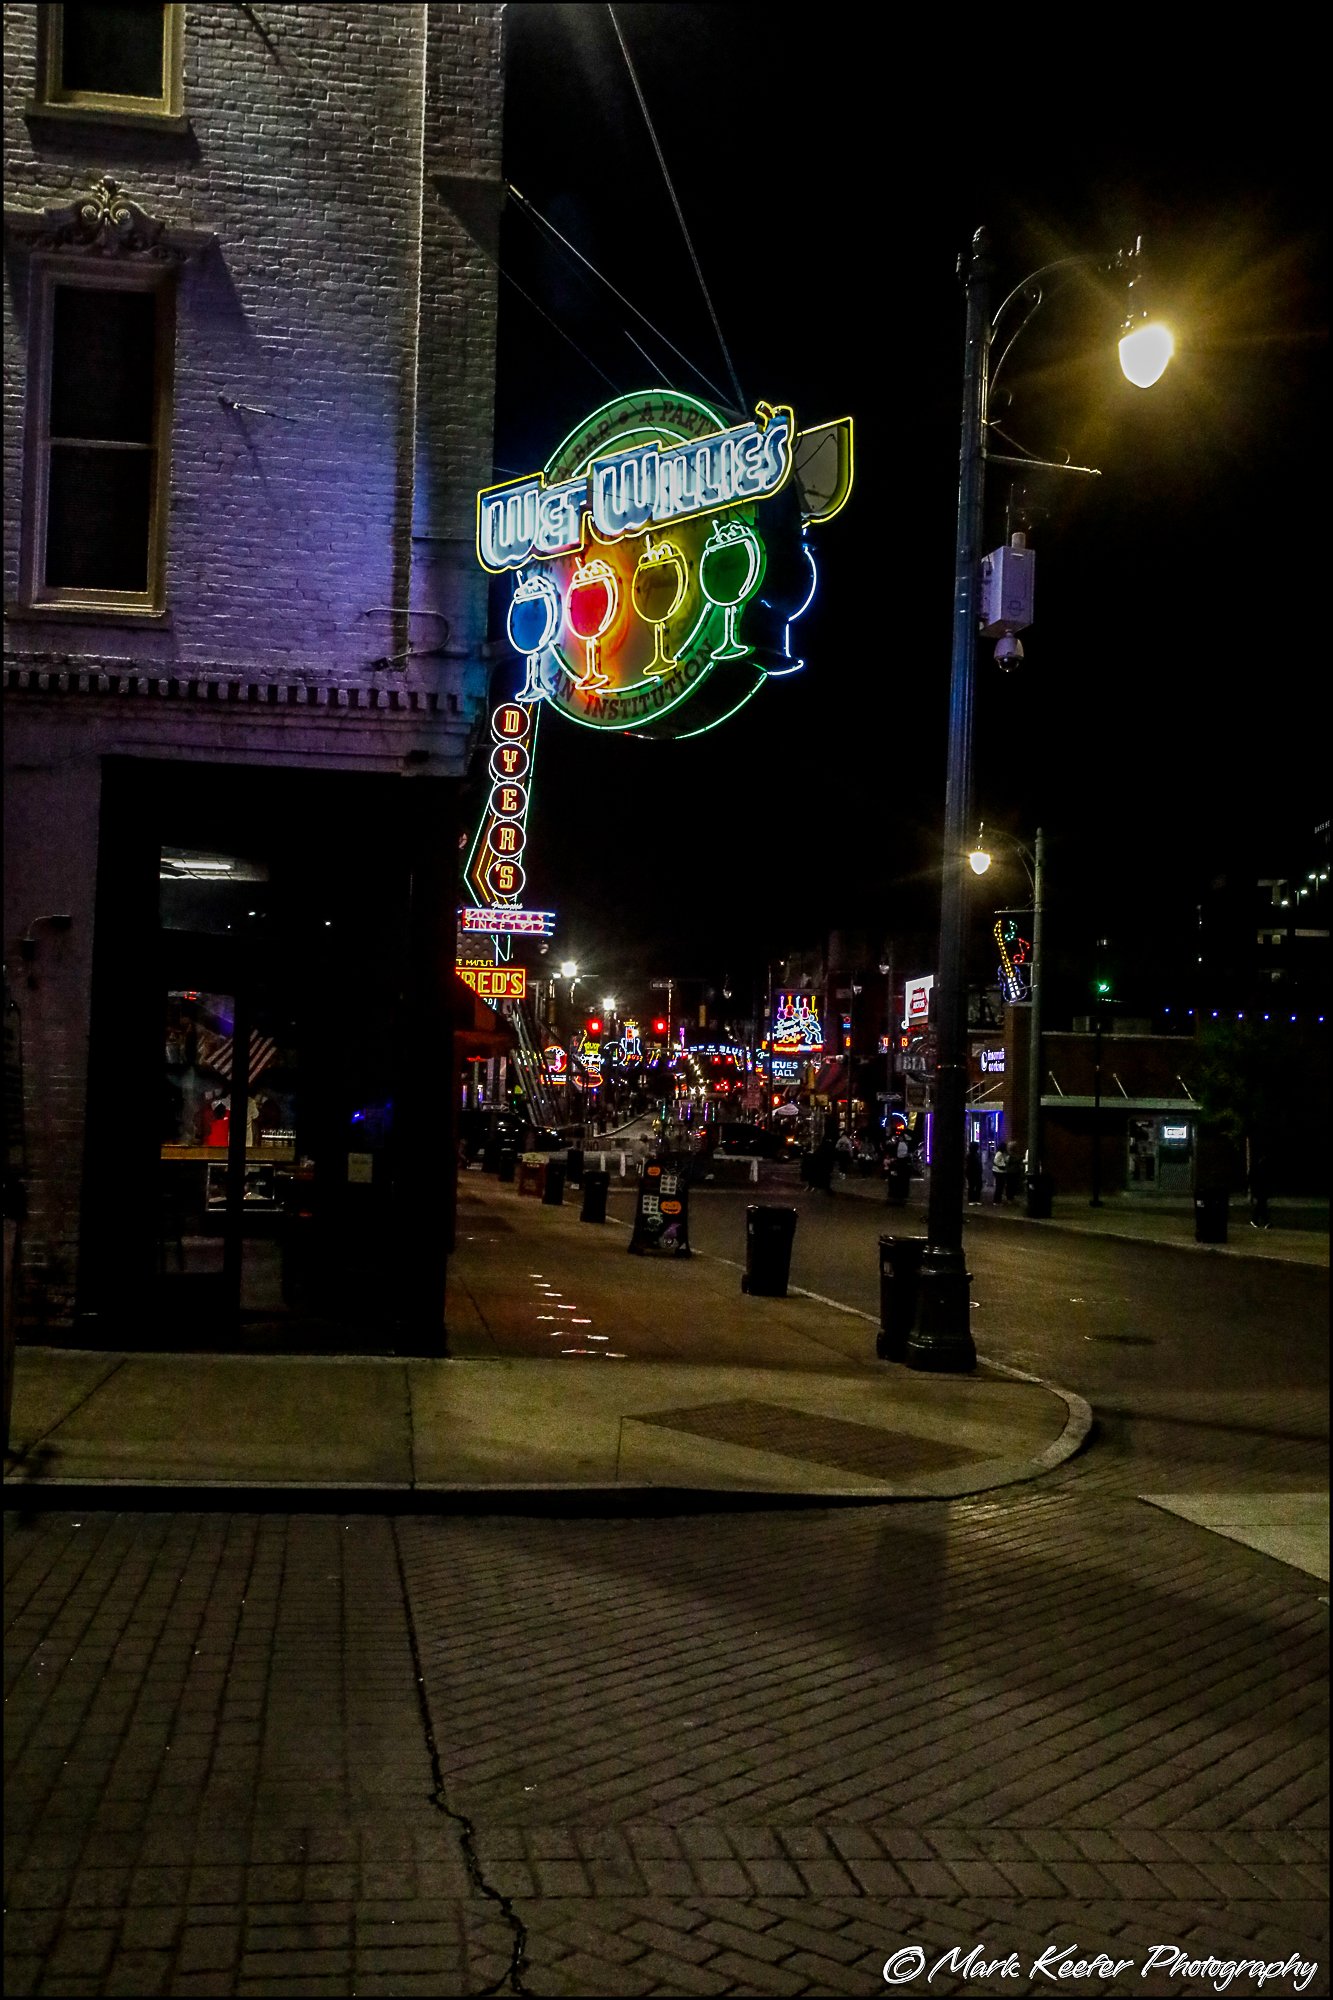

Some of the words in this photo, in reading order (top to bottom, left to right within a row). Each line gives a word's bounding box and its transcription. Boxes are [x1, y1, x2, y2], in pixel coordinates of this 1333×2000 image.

[572, 421, 612, 461] BAR
[638, 400, 655, 423] A
[480, 484, 588, 568] WET
[548, 668, 577, 702] AN
[583, 639, 714, 720] INSTITUTION
[495, 709, 520, 890] DYER'S
[464, 919, 507, 931] SINCE
[511, 921, 545, 932] 1912
[457, 971, 523, 995] RED'S
[987, 1047, 1005, 1061] insomni
